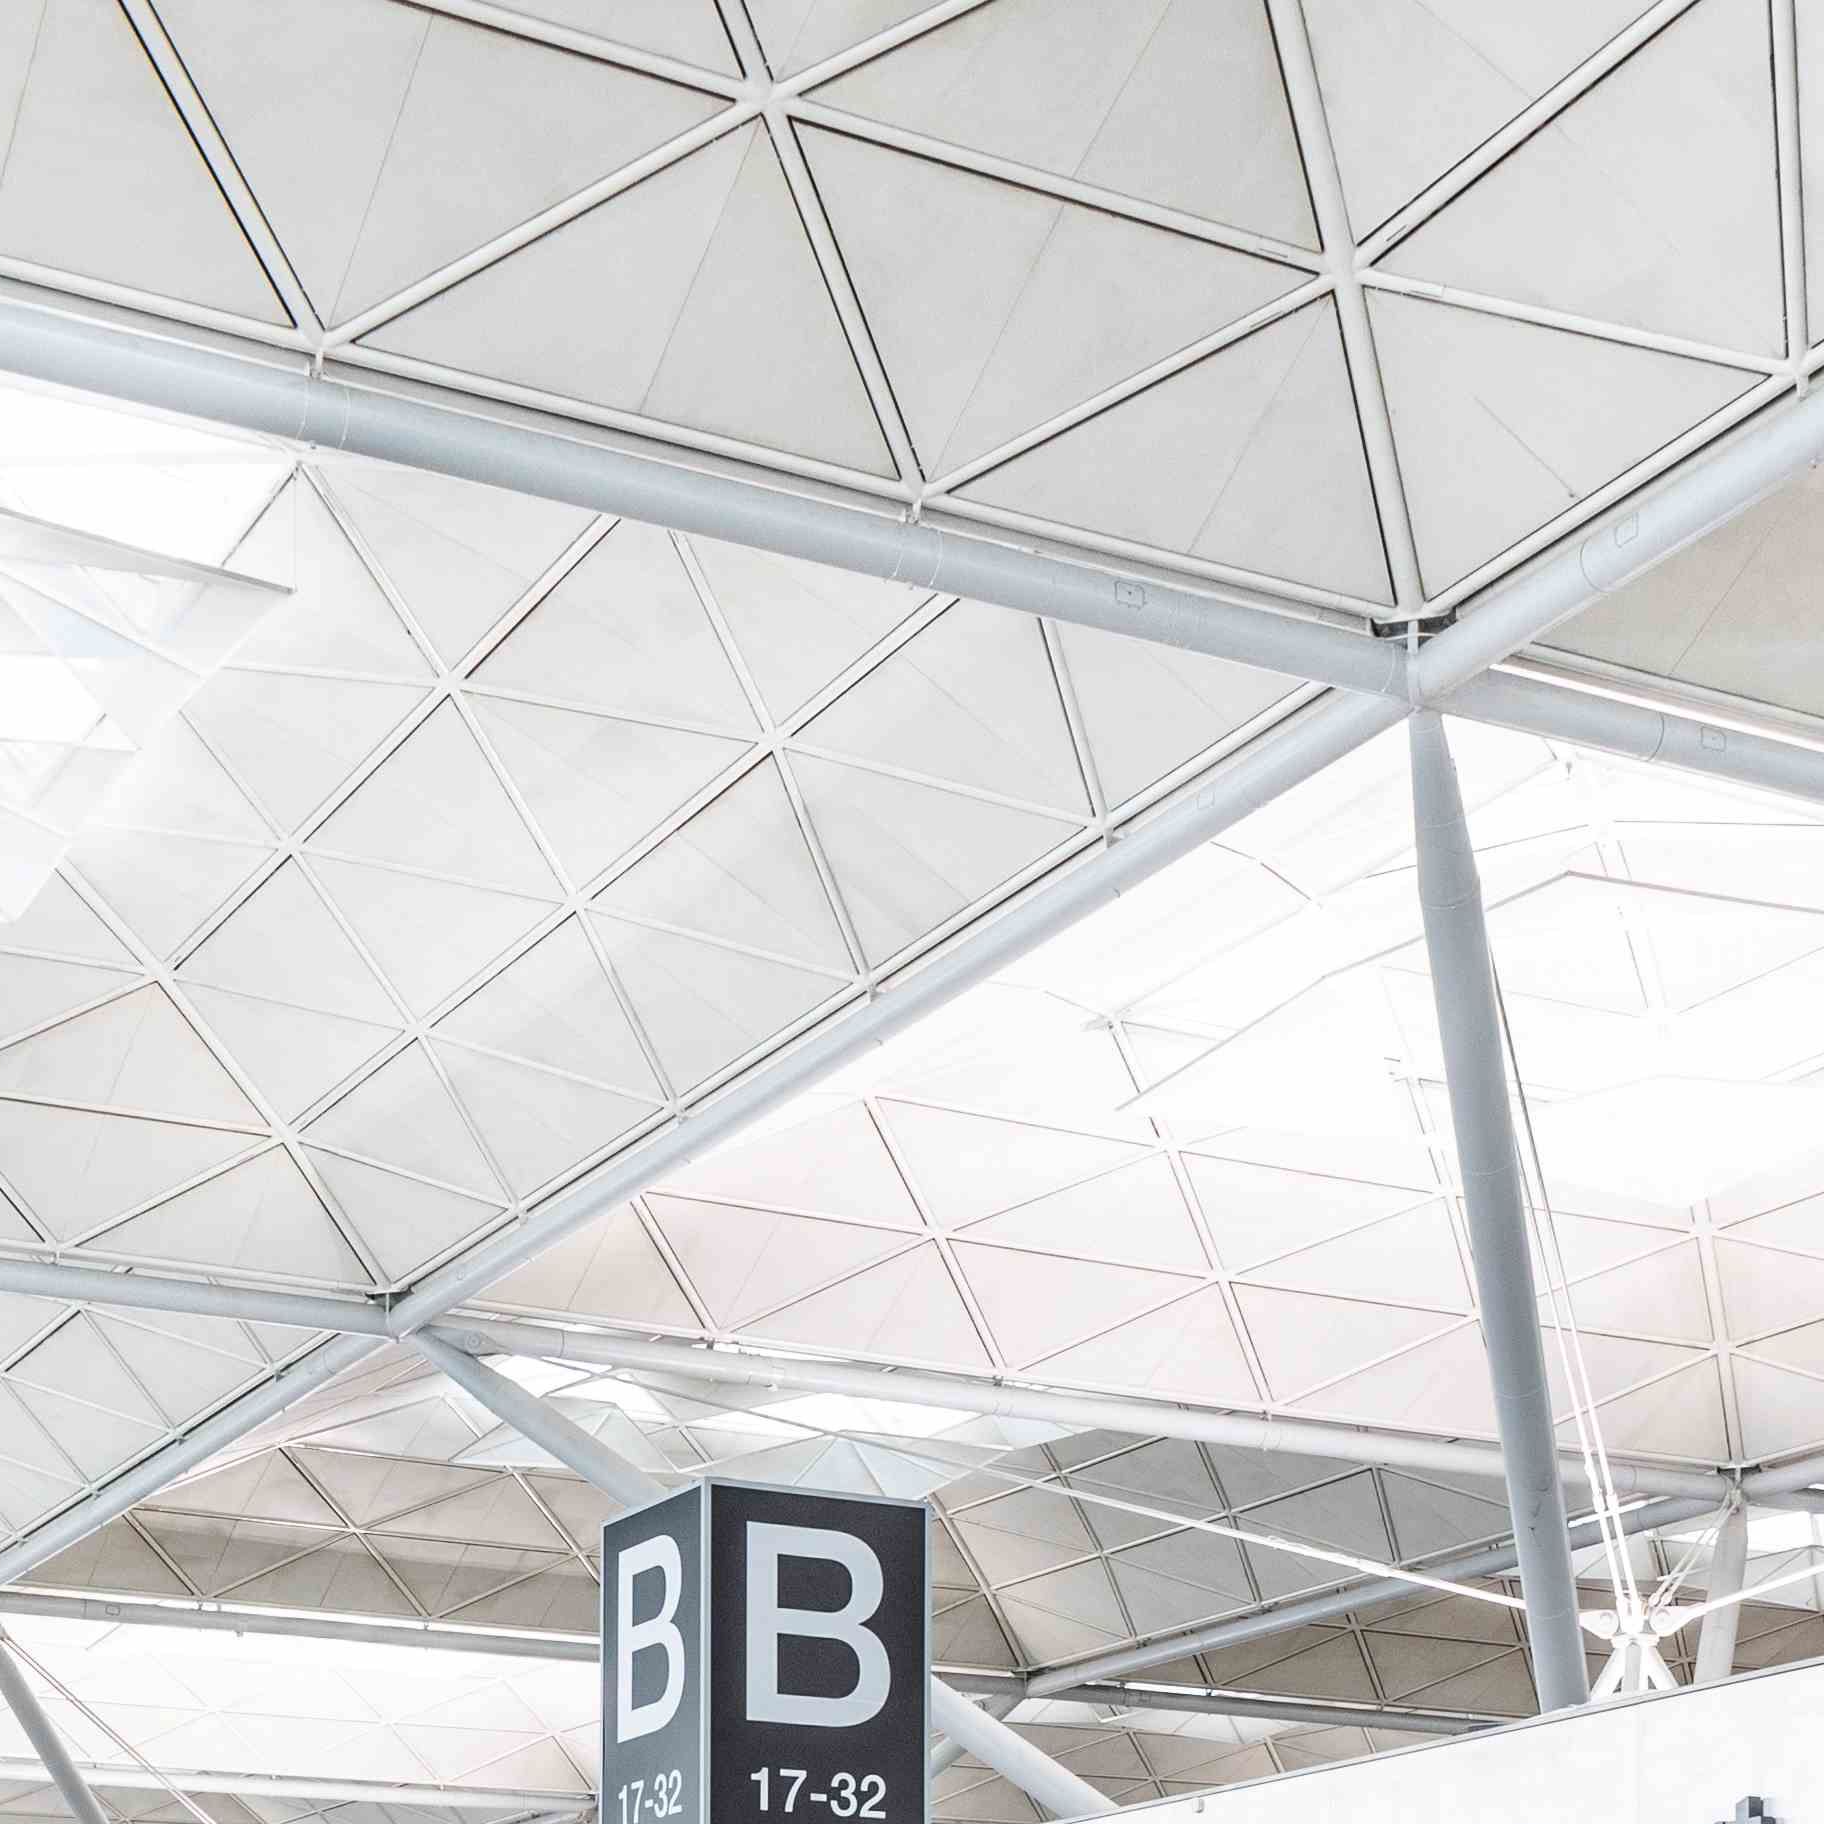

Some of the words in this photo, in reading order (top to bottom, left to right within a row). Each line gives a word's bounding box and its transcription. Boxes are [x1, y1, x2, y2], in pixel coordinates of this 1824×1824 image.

[617, 1534, 686, 1744] B
[746, 1521, 891, 1728] B
[750, 1767, 887, 1819] 17-32
